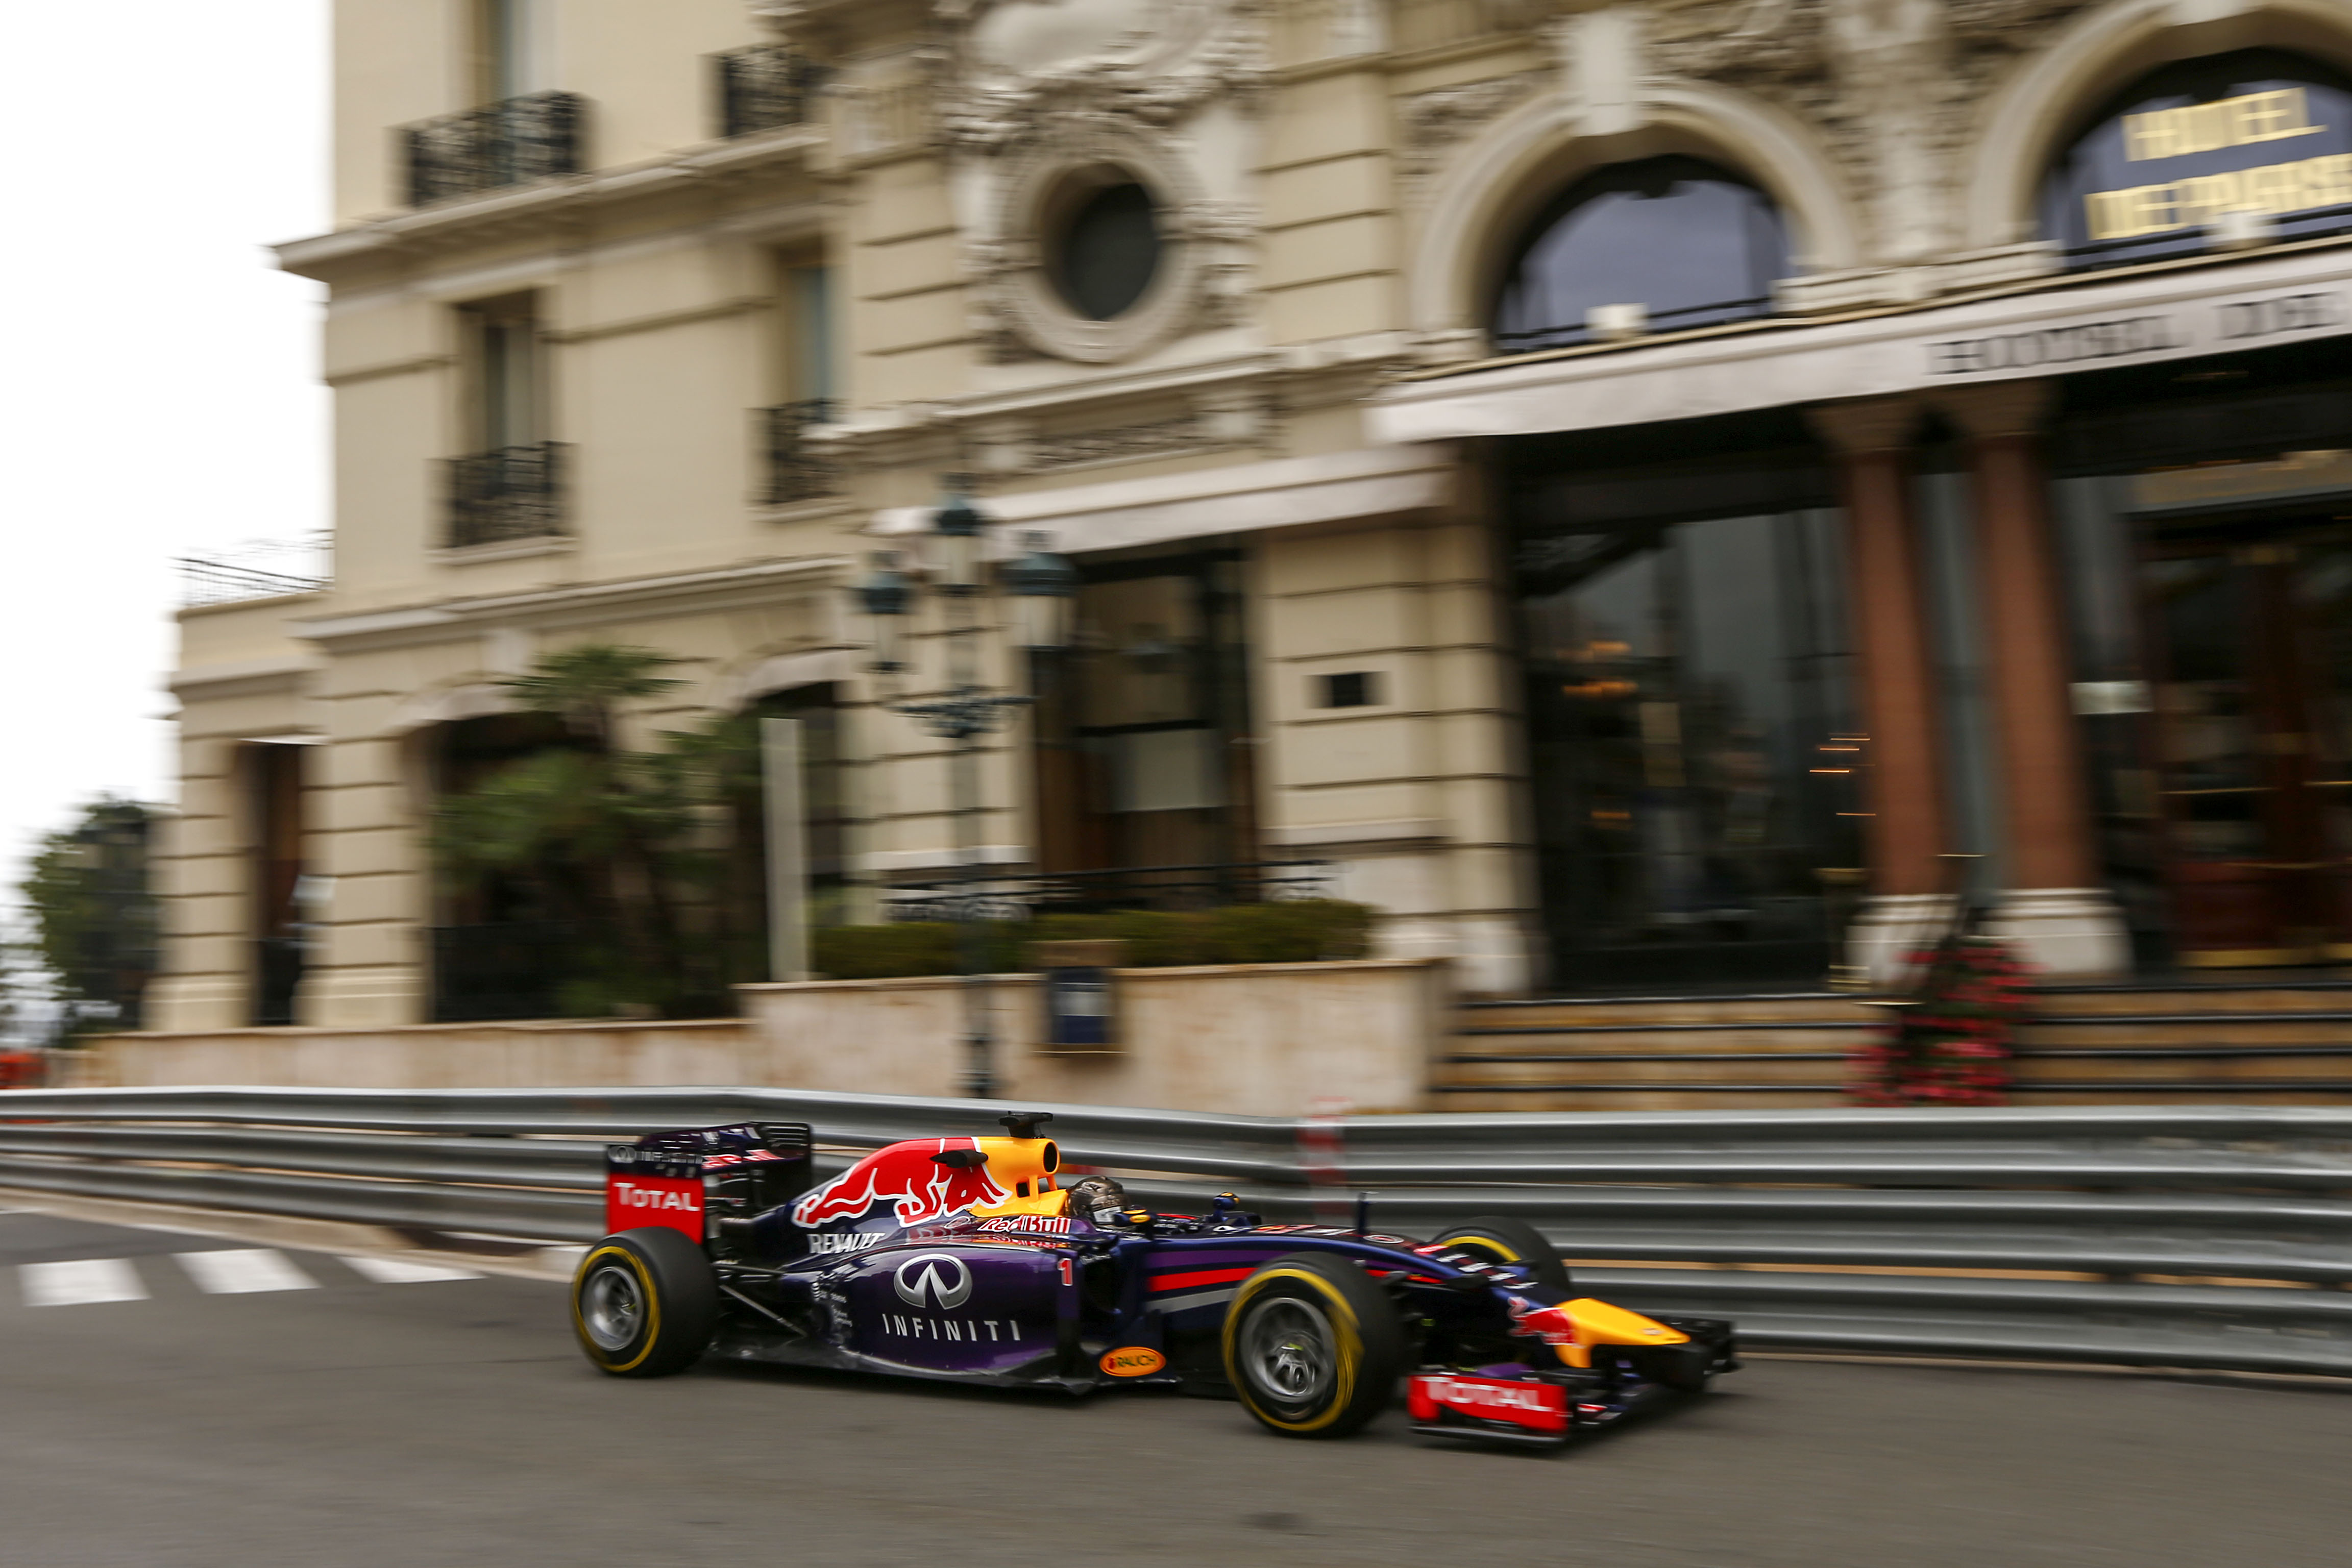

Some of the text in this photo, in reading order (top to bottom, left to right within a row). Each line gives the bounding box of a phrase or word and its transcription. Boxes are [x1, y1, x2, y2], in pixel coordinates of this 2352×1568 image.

[612, 1182, 701, 1212] TOTAL
[806, 1232, 887, 1255] RENAULT
[1057, 1258, 1072, 1286] 1
[882, 1313, 1021, 1342] INFINITI
